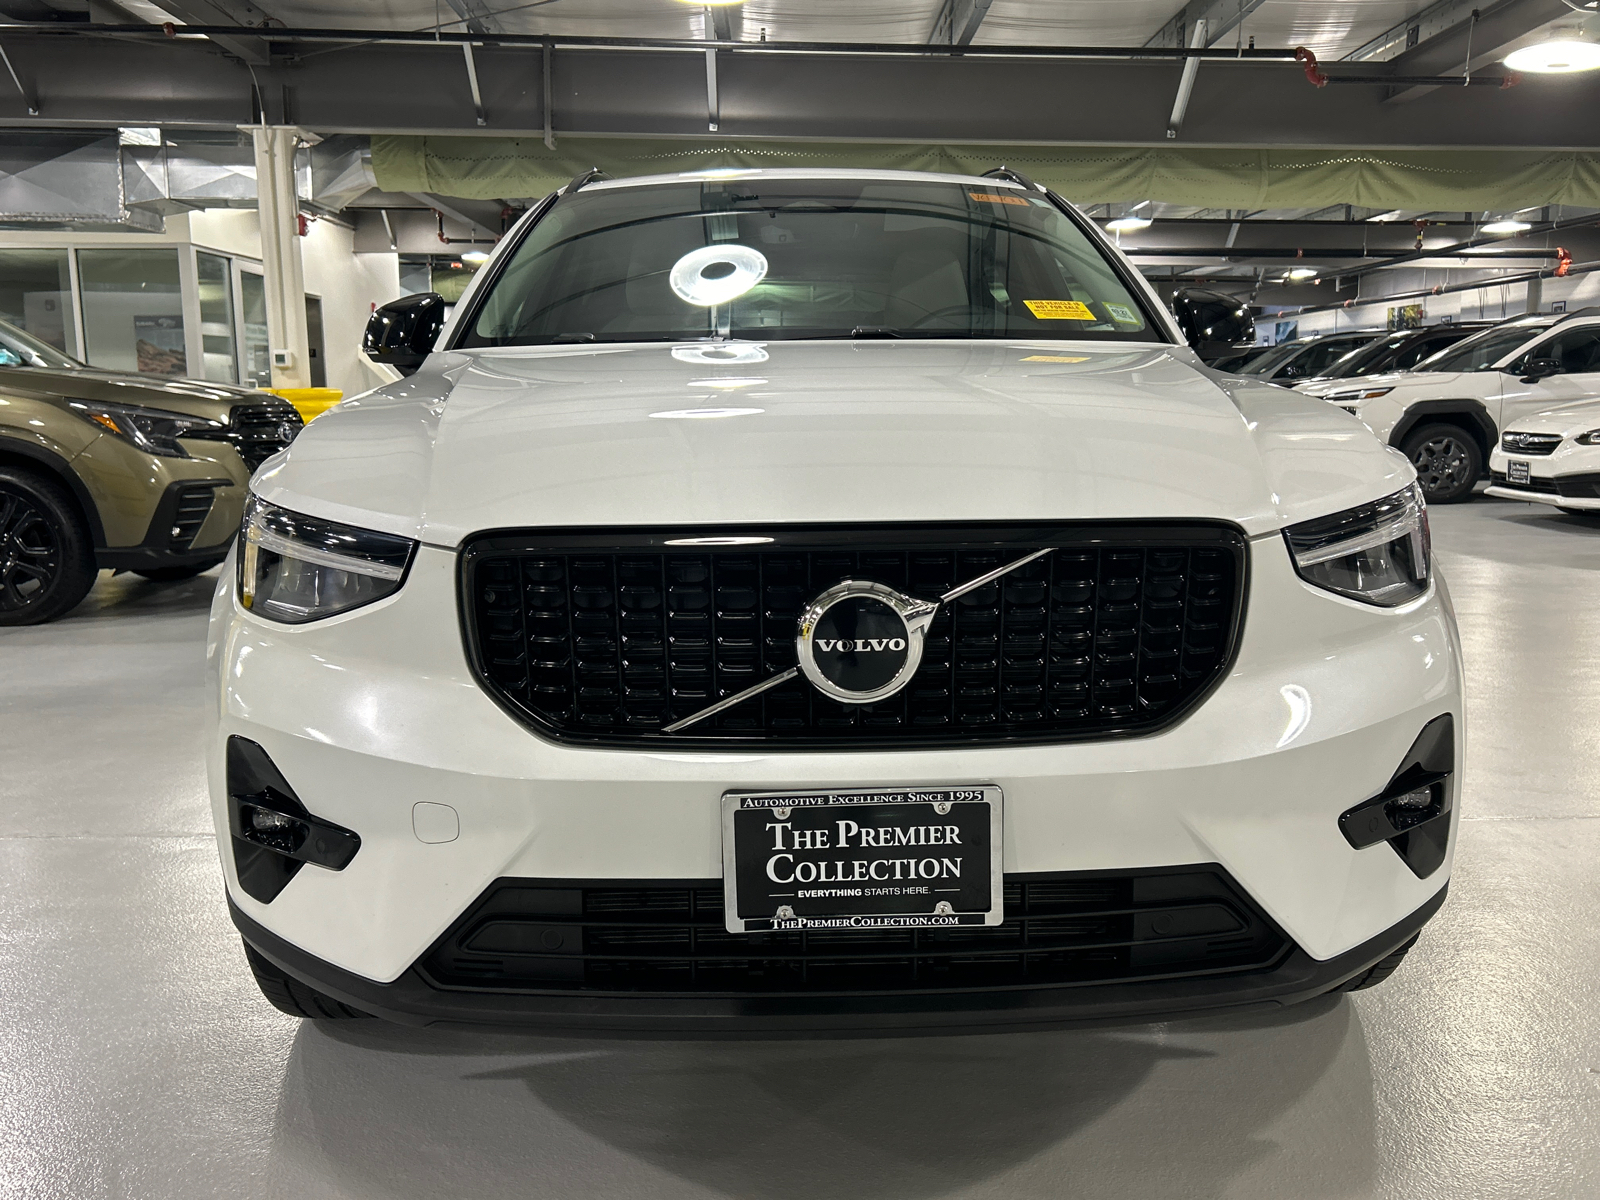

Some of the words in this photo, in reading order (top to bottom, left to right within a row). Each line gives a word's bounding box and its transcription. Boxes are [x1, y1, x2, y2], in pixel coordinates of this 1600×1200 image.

[815, 638, 906, 652] VOLVO
[743, 797, 825, 808] AUTOMOTIVE
[828, 793, 905, 805] EXCELLENCE
[907, 792, 944, 803] SINCE
[948, 790, 982, 802] 1995
[765, 821, 831, 850] THE
[835, 819, 963, 848] PREMIER
[765, 853, 963, 884] COLLECTION
[797, 887, 863, 898] EVERYTHING
[864, 887, 901, 896] STARTS
[902, 886, 932, 895] HERE.
